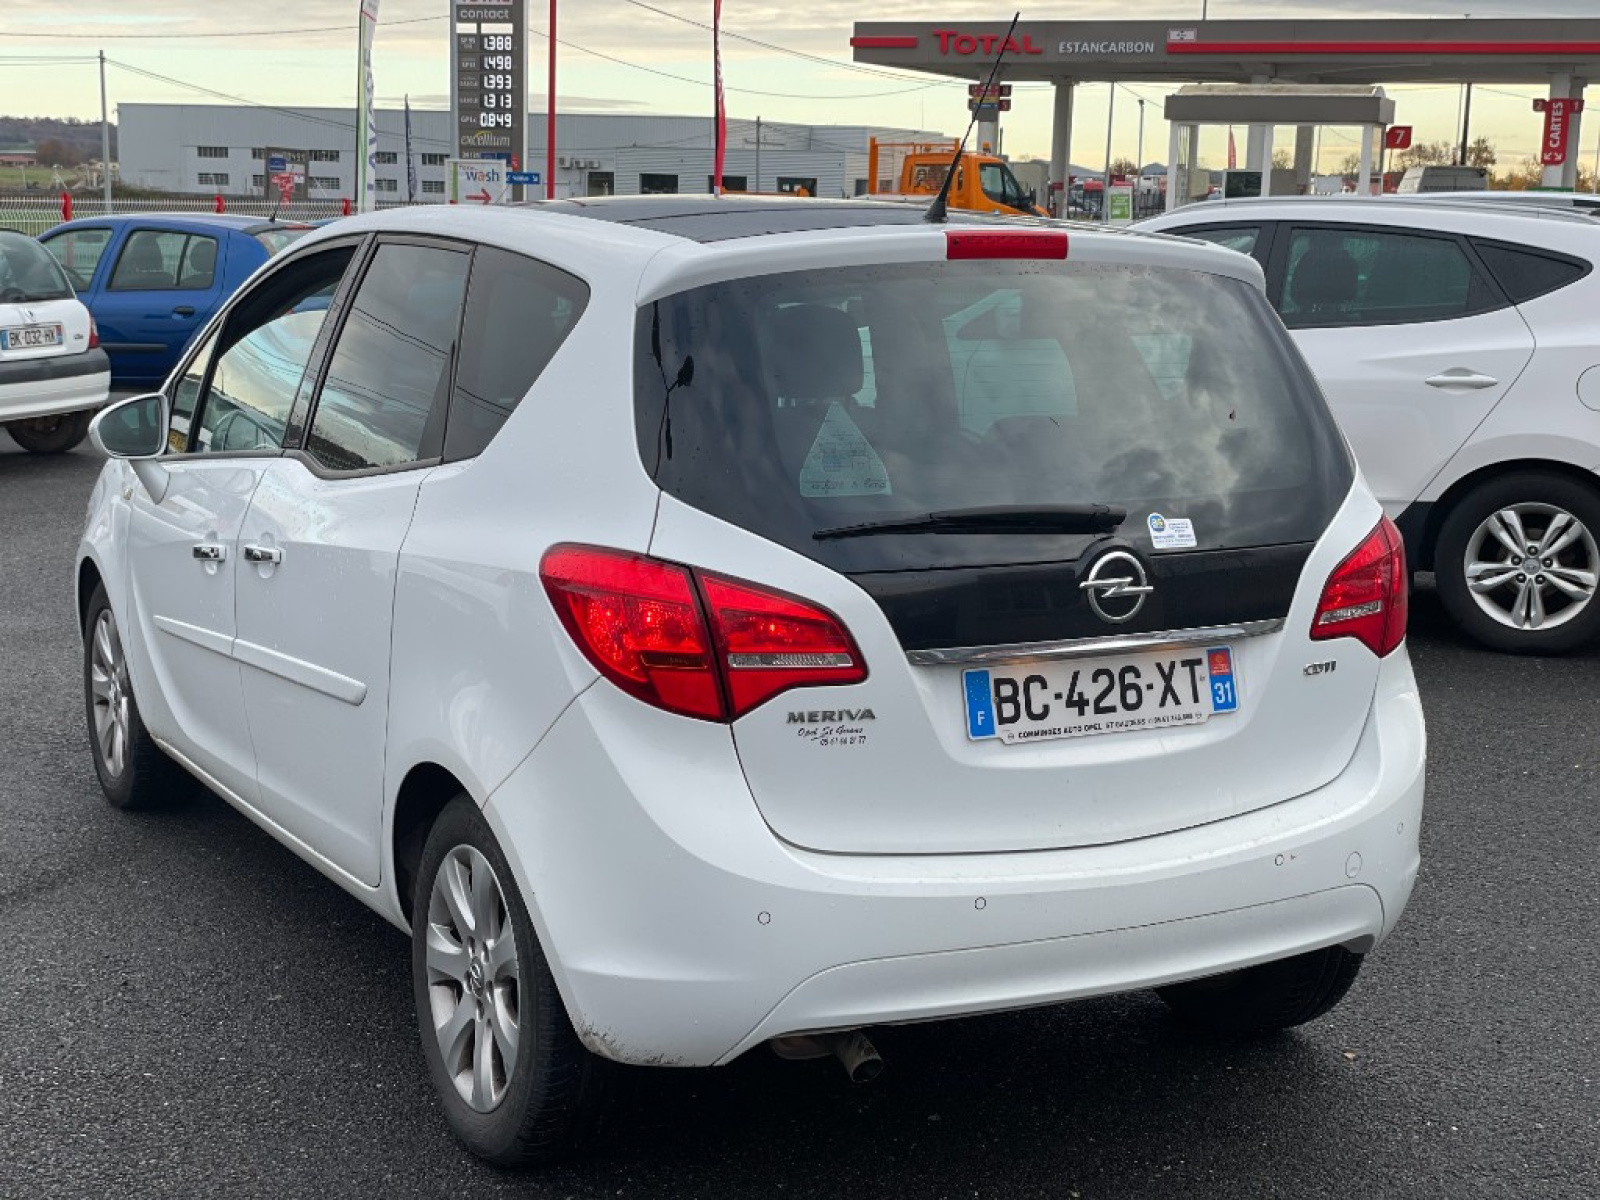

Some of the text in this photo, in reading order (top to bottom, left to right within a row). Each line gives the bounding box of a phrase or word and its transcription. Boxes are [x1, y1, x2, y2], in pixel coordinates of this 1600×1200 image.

[460, 8, 510, 19] contact
[933, 30, 1043, 54] TOTAL
[1058, 41, 1154, 53] ESTANCARBON
[1550, 102, 1564, 148] CARTES
[461, 132, 510, 146] excellium
[1394, 130, 1405, 144] 7
[466, 168, 500, 182] wash
[993, 658, 1204, 726] BC-426-XT
[1213, 681, 1233, 704] 31
[786, 708, 877, 724] MERIVA
[977, 711, 986, 725] F
